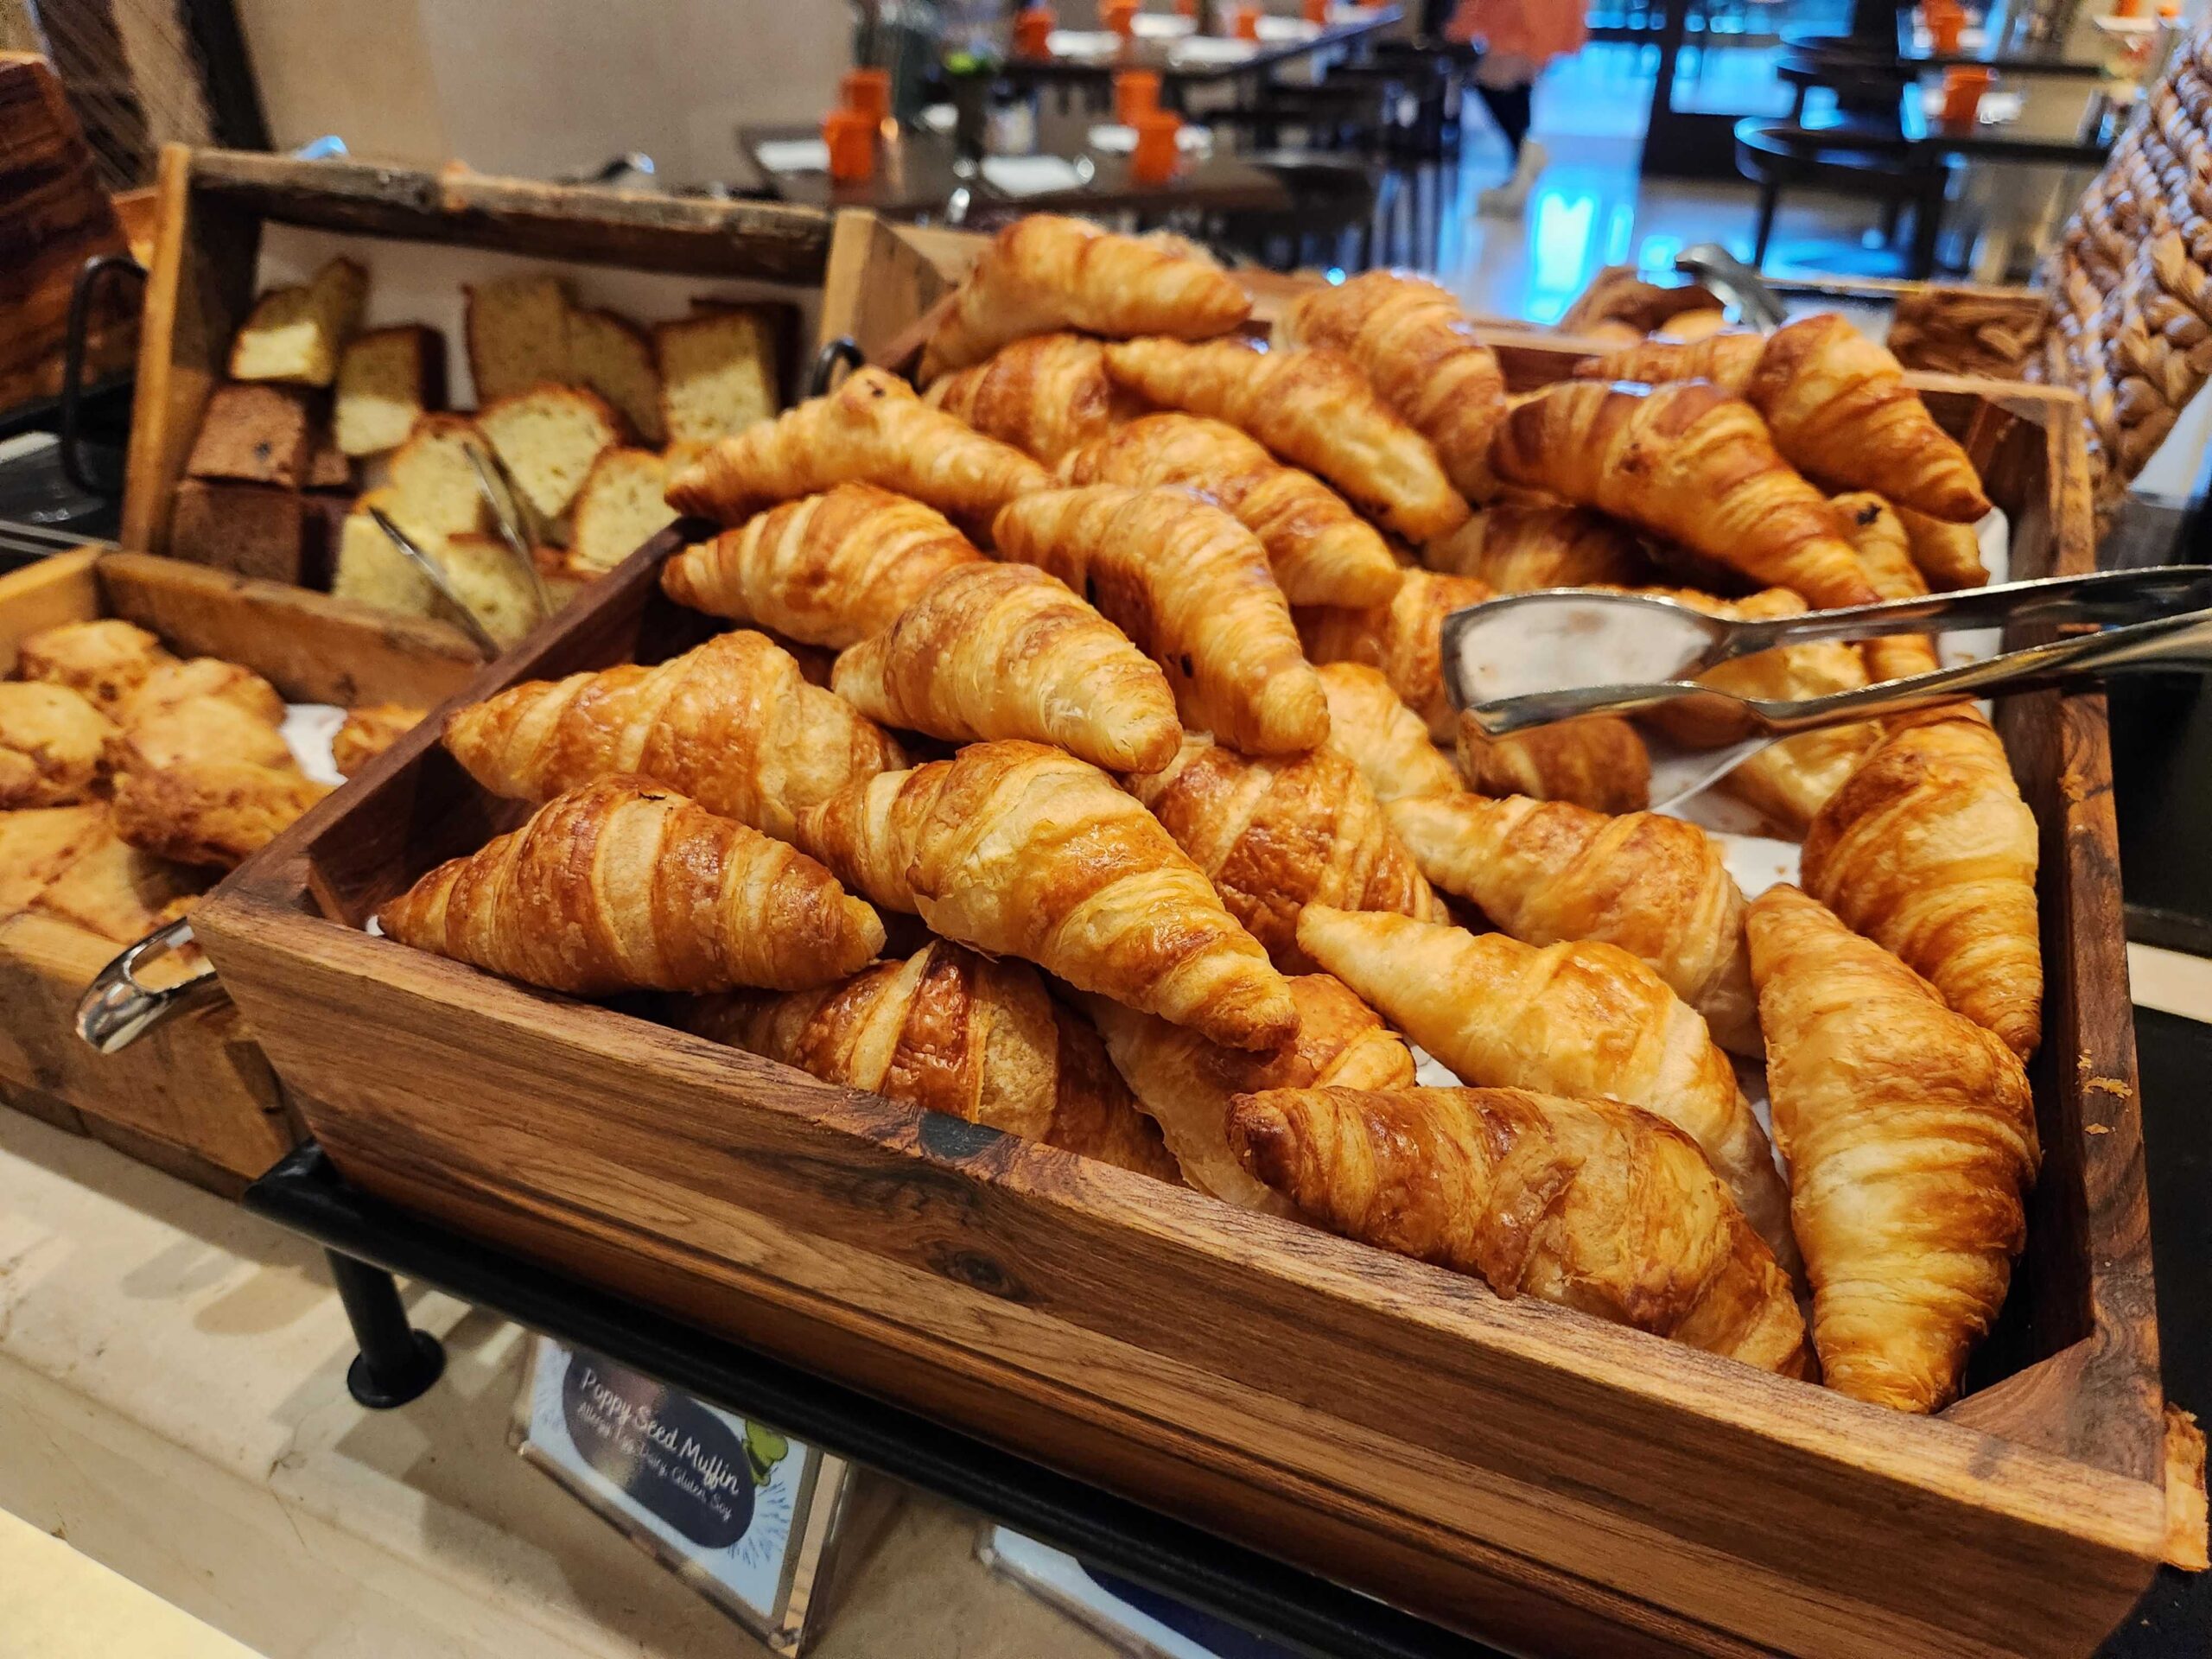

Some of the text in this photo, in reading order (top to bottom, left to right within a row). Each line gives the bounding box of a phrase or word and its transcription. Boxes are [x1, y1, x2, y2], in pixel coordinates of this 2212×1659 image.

[581, 1367, 741, 1497] Poppy Seed Muffin
